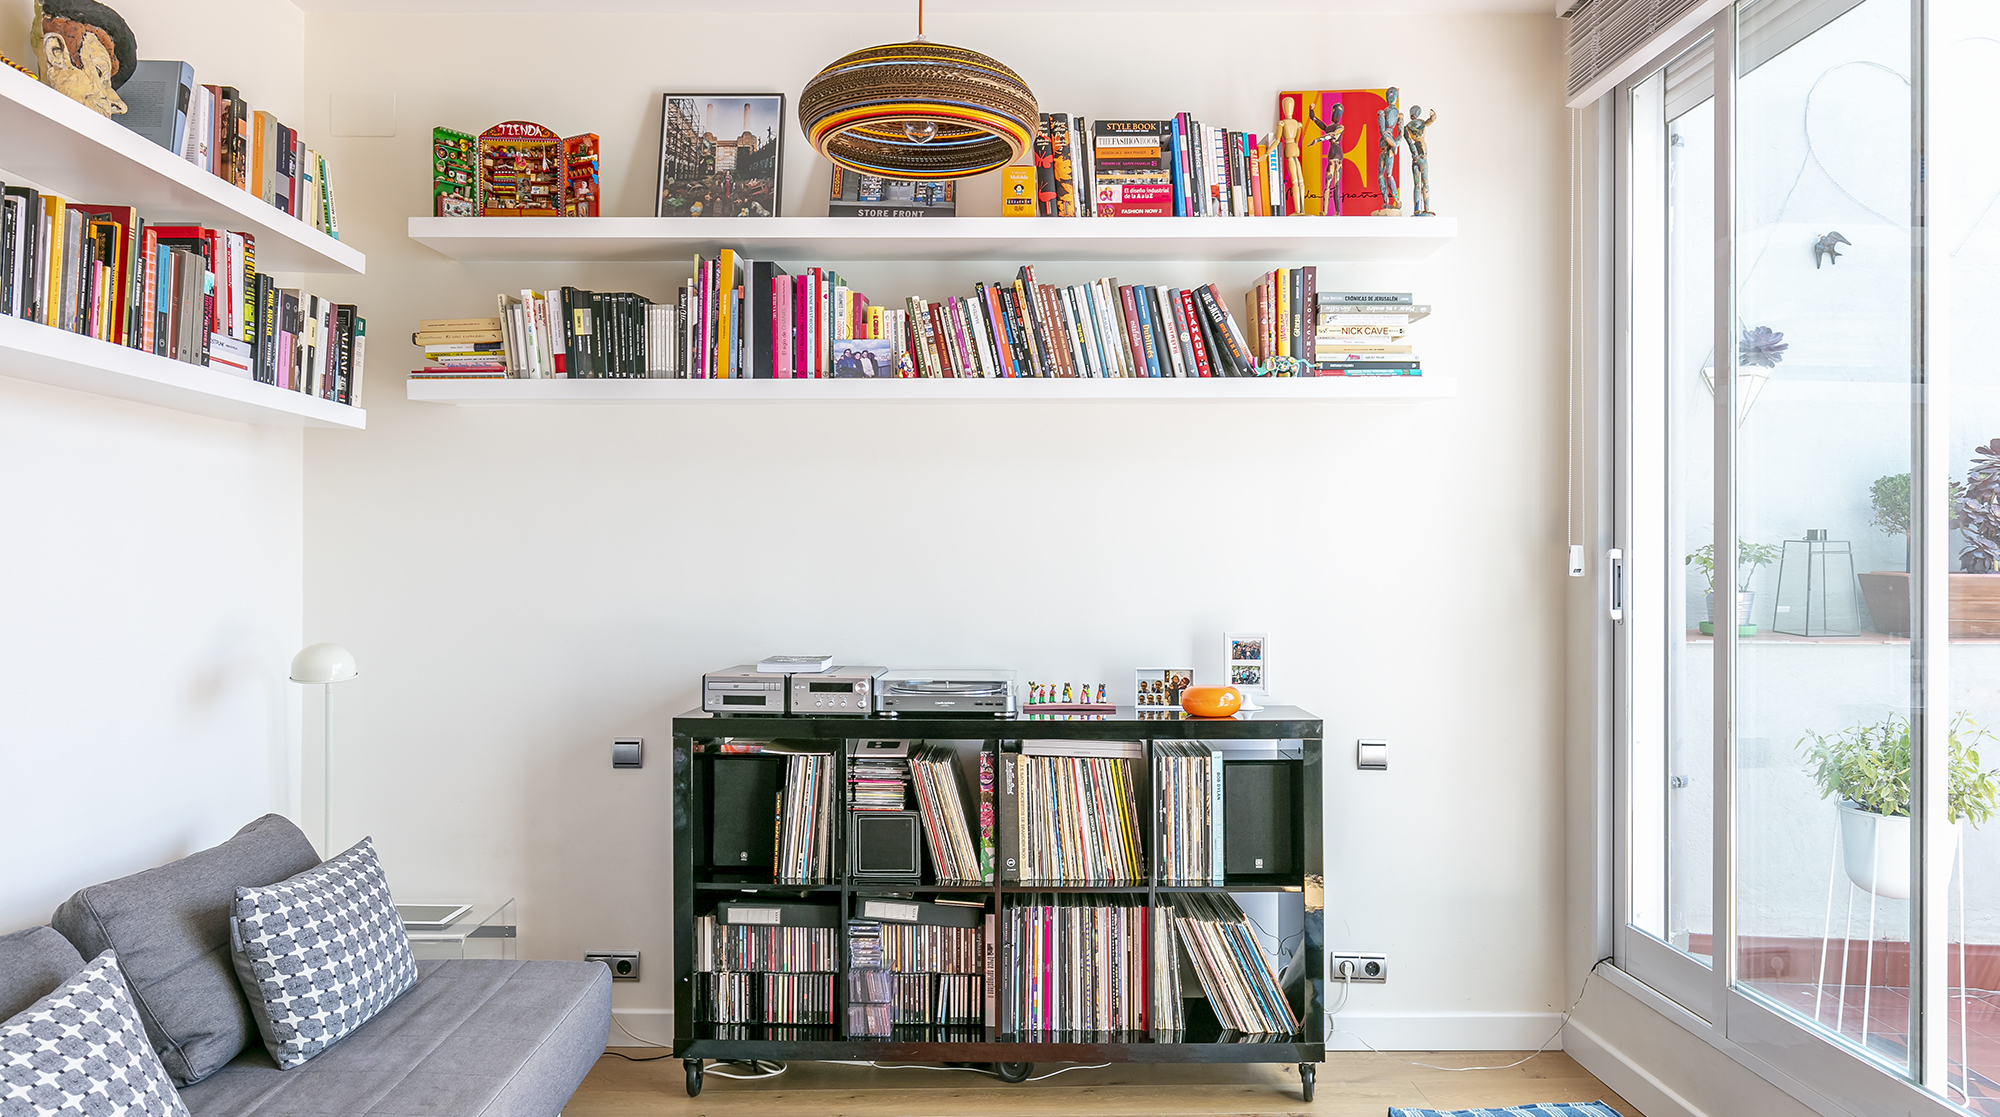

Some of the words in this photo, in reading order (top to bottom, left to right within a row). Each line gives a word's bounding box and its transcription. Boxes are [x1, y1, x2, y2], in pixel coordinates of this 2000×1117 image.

[499, 124, 542, 136] TIENDA
[1106, 123, 1131, 131] STYLE
[1132, 123, 1156, 131] BOOK
[1223, 156, 1231, 188] MARKETING
[1249, 148, 1259, 177] FRUITS
[858, 209, 890, 217] STORE
[893, 210, 924, 218] FRONT
[1172, 296, 1187, 331] MAUS
[1200, 290, 1213, 305] JOE
[1207, 302, 1223, 323] SACCO
[1129, 319, 1141, 347] estafados
[1141, 323, 1155, 359] Dublinés
[1166, 321, 1179, 354] HAARMANN
[1183, 296, 1205, 357] METAMAUS
[1341, 327, 1363, 335] NICK
[1364, 327, 1389, 335] CAVE
[340, 351, 348, 374] RAP
